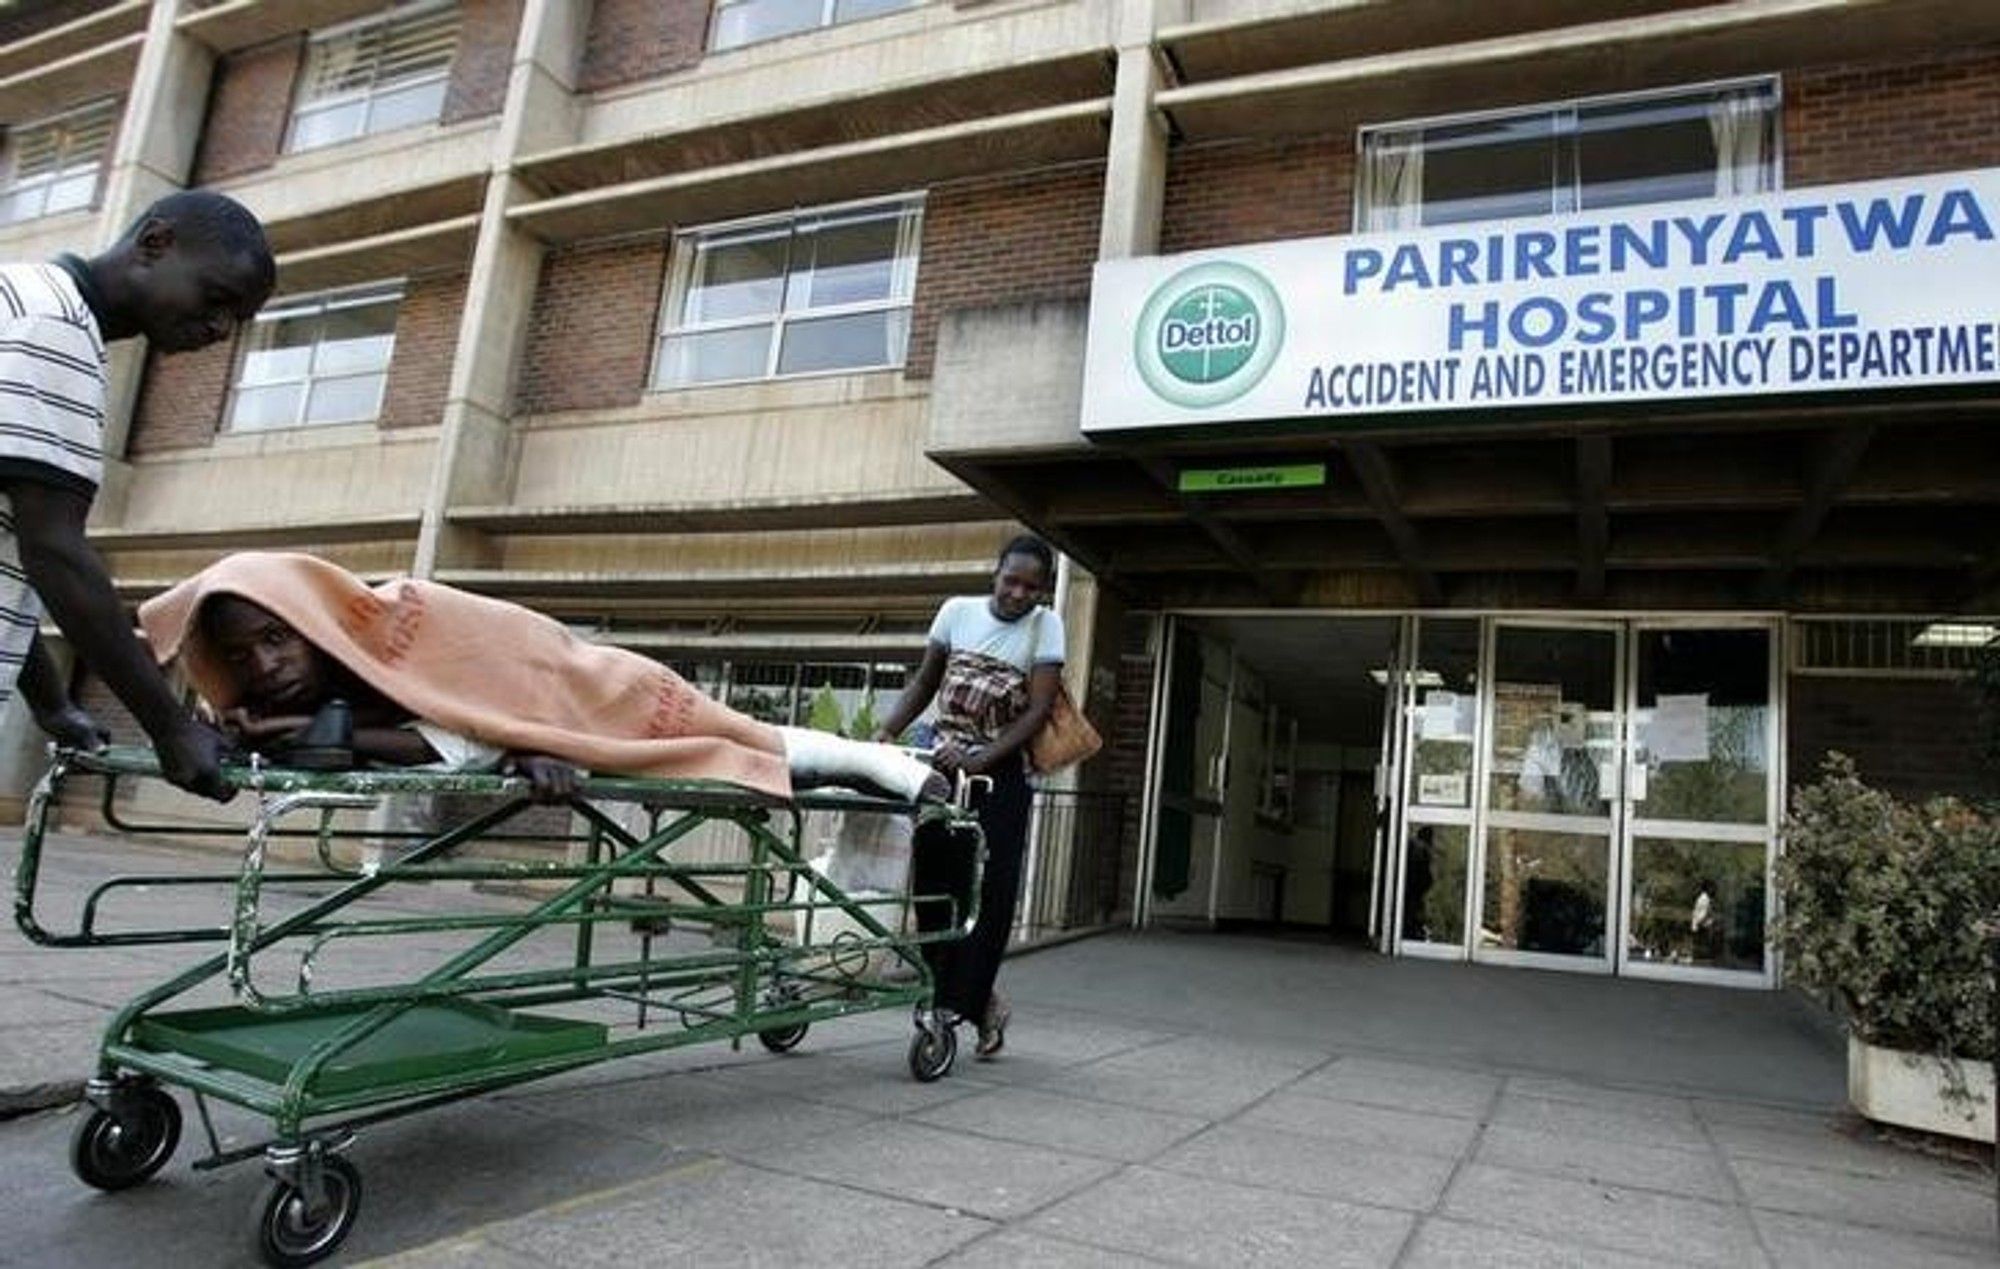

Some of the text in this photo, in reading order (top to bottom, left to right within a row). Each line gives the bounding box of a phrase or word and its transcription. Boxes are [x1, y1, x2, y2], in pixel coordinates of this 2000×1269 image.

[1343, 189, 1995, 295] PARIRENYATWA
[1166, 316, 1251, 348] Dettol
[1448, 276, 1858, 351] HOSPITAL
[1305, 323, 2000, 408] ACCIDENT AND EMERGENCY DEPARTME
